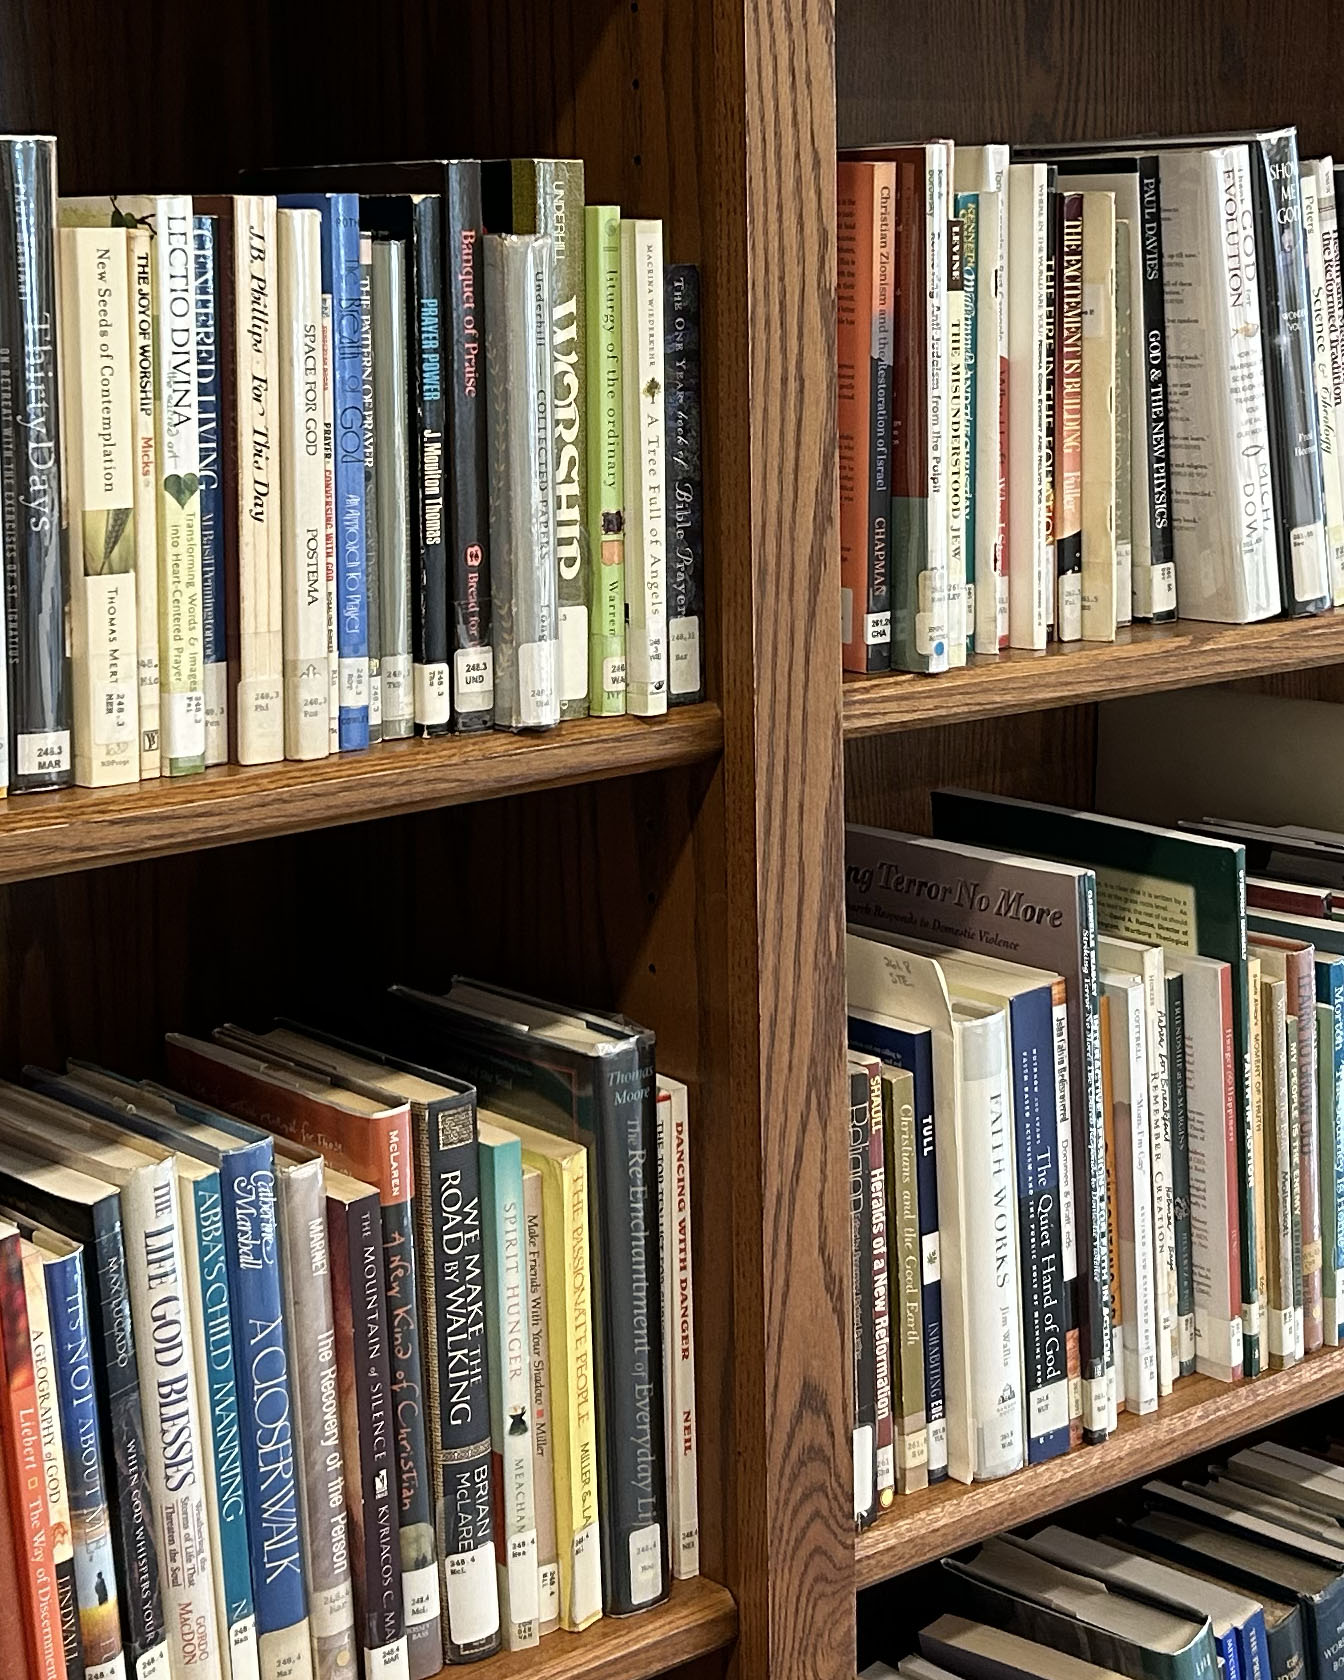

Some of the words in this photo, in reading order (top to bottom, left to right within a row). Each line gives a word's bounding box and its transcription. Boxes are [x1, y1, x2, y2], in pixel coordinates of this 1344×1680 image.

[1144, 178, 1155, 217] PAUL
[167, 216, 190, 320] LECTIO
[248, 225, 267, 264] J.B.
[1145, 222, 1157, 280] DAVIES
[245, 268, 268, 354] Phillips
[420, 298, 440, 350] PRAYER
[951, 320, 960, 357] THE
[304, 324, 316, 376] SPACE
[1149, 330, 1161, 363] GOD
[1151, 367, 1162, 381] &
[171, 327, 192, 429] DIVINA
[251, 375, 268, 418] For
[305, 381, 317, 413] FOR
[422, 353, 441, 401] POWER
[1152, 384, 1163, 416] THE
[253, 427, 269, 468] This
[306, 418, 317, 456] GOD
[552, 295, 580, 580] WORSHIP
[951, 362, 961, 519] MISUNDERSTOOD
[1153, 420, 1164, 459] NEW
[249, 474, 269, 523] Day
[1154, 464, 1167, 529] PHYSICS
[306, 528, 317, 606] POSTEMA
[874, 517, 885, 595] CHAPMAN
[950, 525, 960, 562] JEW
[465, 662, 488, 674] 248.3
[465, 674, 485, 685] UND
[877, 861, 953, 903] Terror
[955, 879, 990, 912] No
[994, 890, 1065, 929] More
[922, 1114, 933, 1156] TULL
[989, 1093, 1004, 1180] FAITH
[674, 1121, 687, 1213] DANCING
[1035, 1146, 1048, 1189] The
[152, 1182, 172, 1222] THE
[234, 1175, 263, 1270] Marshall
[248, 1170, 276, 1265] Catherine
[440, 1169, 464, 1255] ROAD
[460, 1197, 480, 1249] WE
[1037, 1192, 1053, 1246] Quiet
[143, 1225, 179, 1290] LIFE
[197, 1190, 224, 1275] ABBA'S
[309, 1217, 327, 1277] MARNEY
[678, 1218, 687, 1274] WITH
[992, 1187, 1010, 1289] WORKS
[443, 1261, 460, 1282] BY
[463, 1254, 484, 1340] MAKE
[1042, 1249, 1056, 1308] Hand
[150, 1297, 183, 1368] GOD
[205, 1278, 231, 1371] CHILD
[249, 1316, 282, 1345] A
[679, 1279, 690, 1361] DANGER
[1044, 1314, 1054, 1330] of
[443, 1283, 473, 1426] WALKING
[469, 1345, 483, 1386] THE
[1045, 1335, 1061, 1380] God
[155, 1374, 195, 1493] BLESSES
[252, 1347, 294, 1490] CLOSER
[682, 1410, 692, 1456] NEIL
[213, 1383, 244, 1522] MANNING
[261, 1480, 301, 1584] WALK
